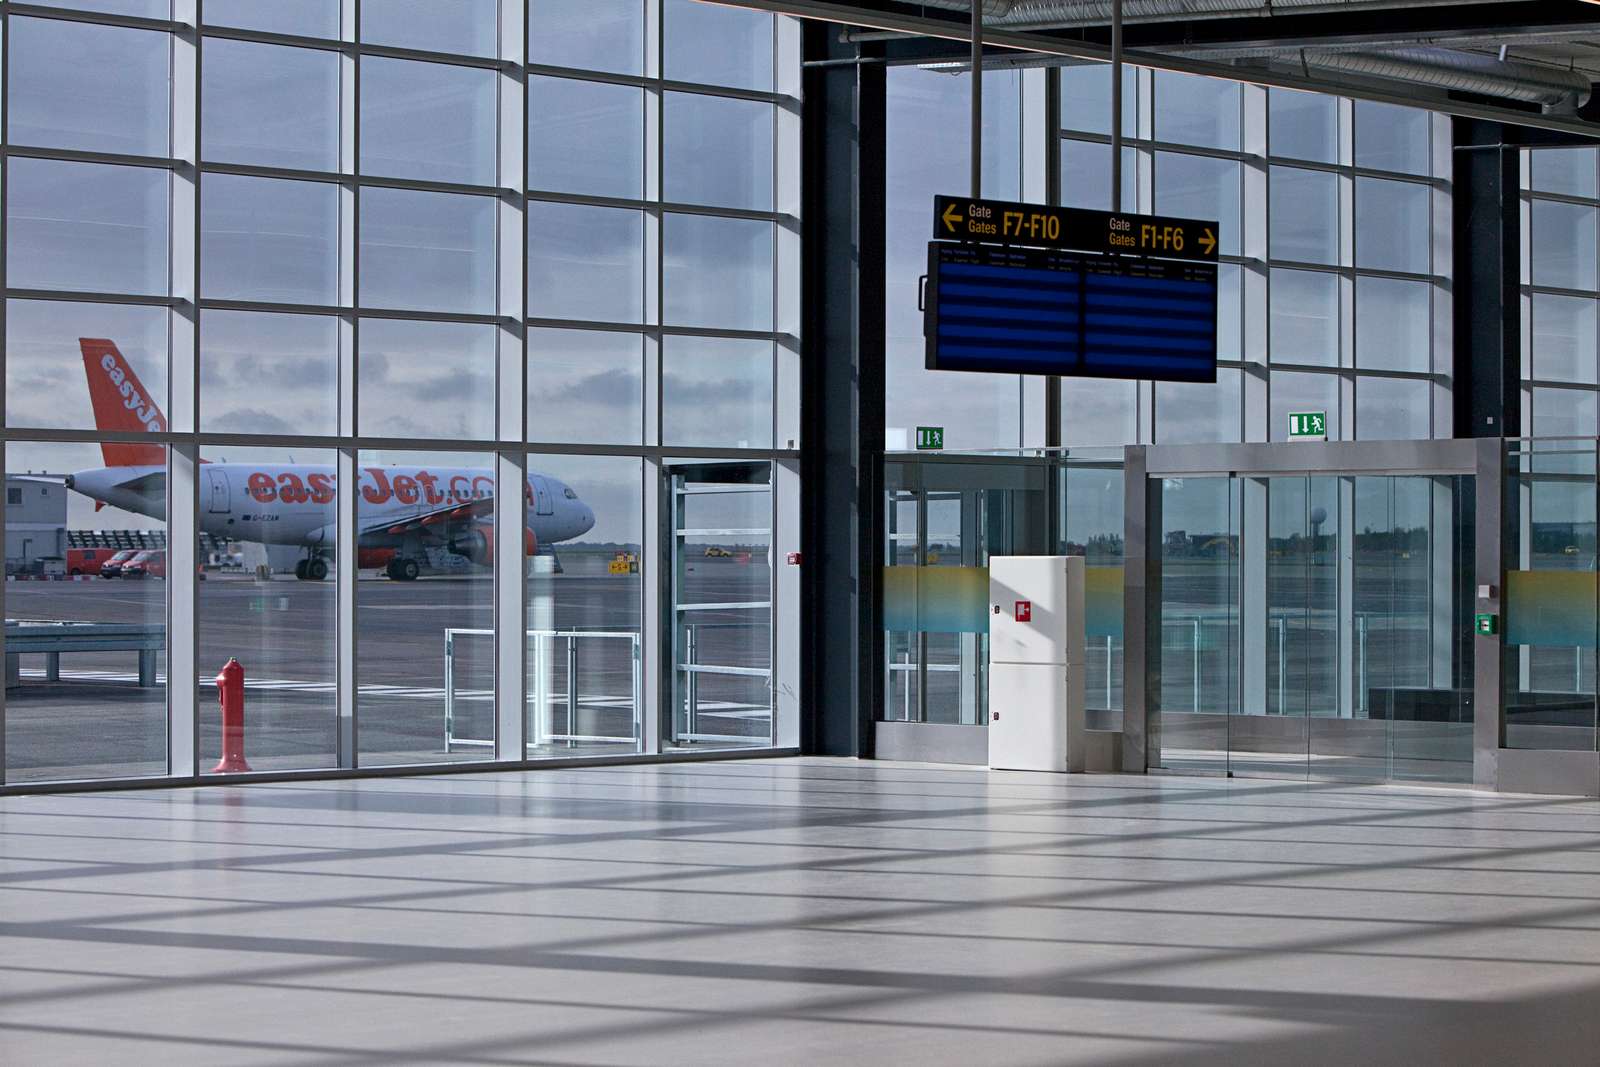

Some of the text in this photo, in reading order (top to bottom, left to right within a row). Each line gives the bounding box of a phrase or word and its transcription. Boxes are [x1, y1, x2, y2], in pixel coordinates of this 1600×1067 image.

[968, 204, 992, 218] Gate
[968, 219, 997, 235] Gates
[1003, 211, 1060, 240] F7-F10
[1109, 217, 1131, 231] Gate
[1109, 232, 1136, 247] Gates
[1141, 223, 1184, 251] F1-F6
[101, 353, 161, 433] easyJe
